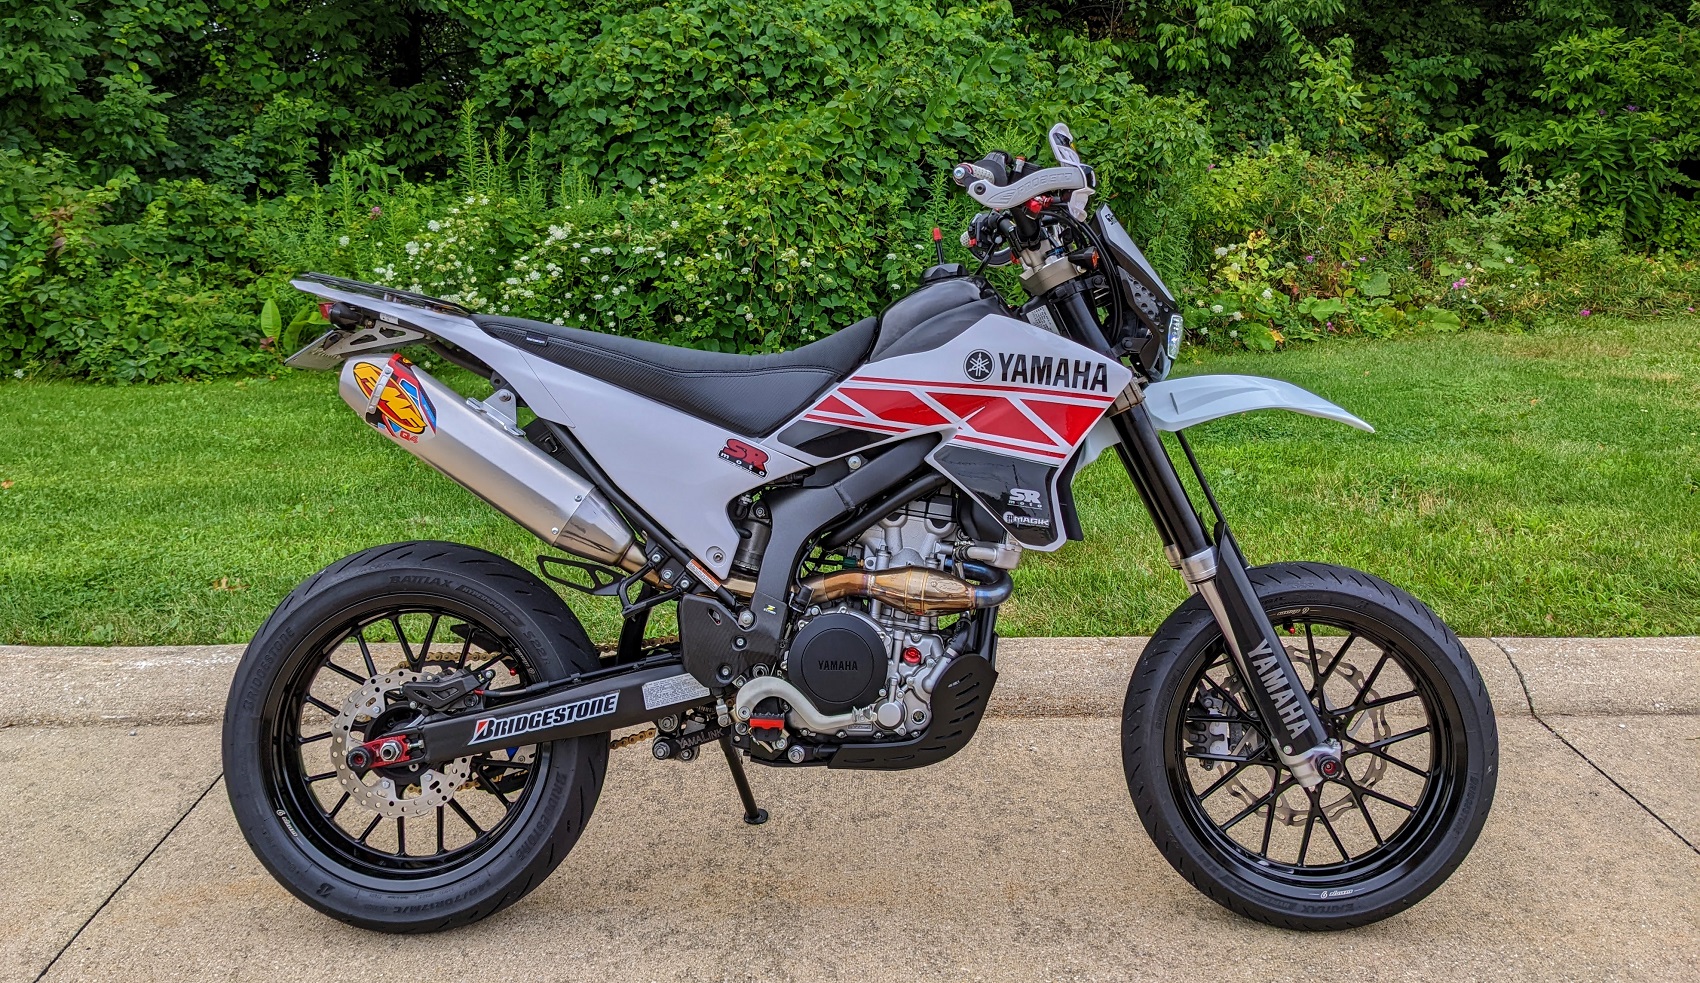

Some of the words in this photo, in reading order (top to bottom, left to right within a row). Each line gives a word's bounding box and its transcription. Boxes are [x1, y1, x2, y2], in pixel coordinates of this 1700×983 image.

[998, 353, 1108, 392] YAMAHA
[400, 430, 418, 444] Q4
[720, 452, 765, 476] moto
[722, 438, 769, 471] SR
[1008, 500, 1042, 508] moto
[1009, 488, 1041, 504] SR
[242, 626, 295, 712] BRIDGESTONE
[818, 660, 858, 671] YAMAHA
[1247, 638, 1311, 740] YAMAHA
[471, 693, 618, 743] BRIDGESTONE
[676, 728, 724, 749] YAMALINK
